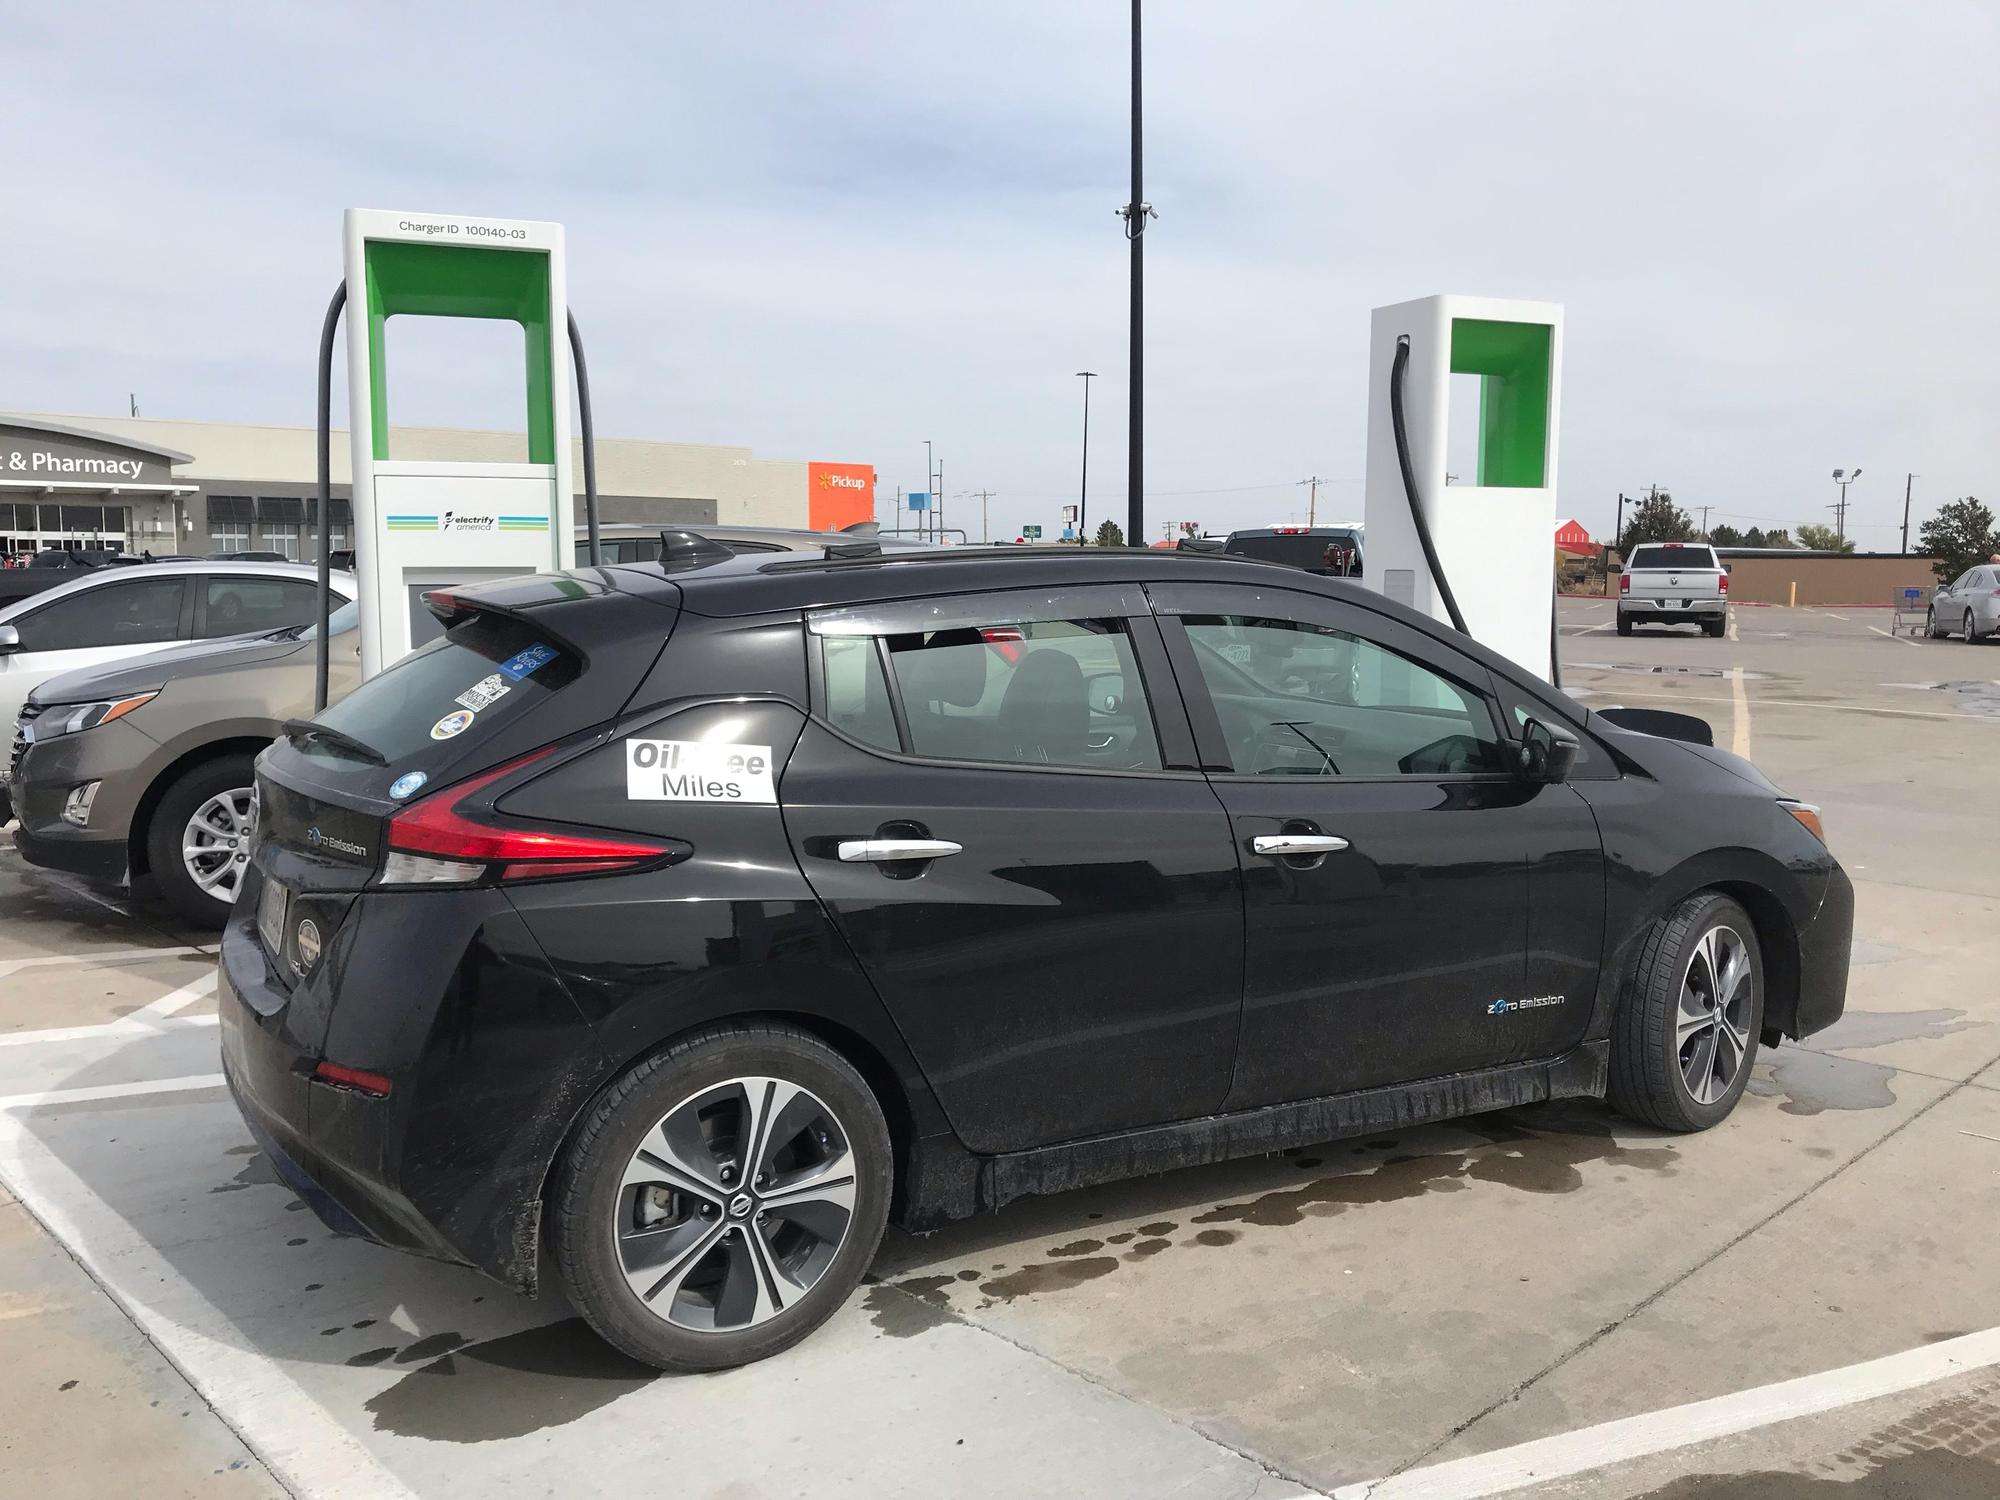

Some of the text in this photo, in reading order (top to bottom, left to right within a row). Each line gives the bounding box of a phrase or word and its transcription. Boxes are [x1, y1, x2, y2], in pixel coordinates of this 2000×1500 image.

[399, 221, 526, 239] Charger ID 100140-03
[9, 451, 27, 471] &
[32, 452, 143, 479] Pharmacy
[832, 475, 865, 491] Pickup
[455, 516, 494, 525] electrify
[633, 742, 680, 769] Oil
[662, 773, 742, 798] Miles
[329, 837, 367, 857] Emission
[1519, 995, 1565, 1009] Emission
